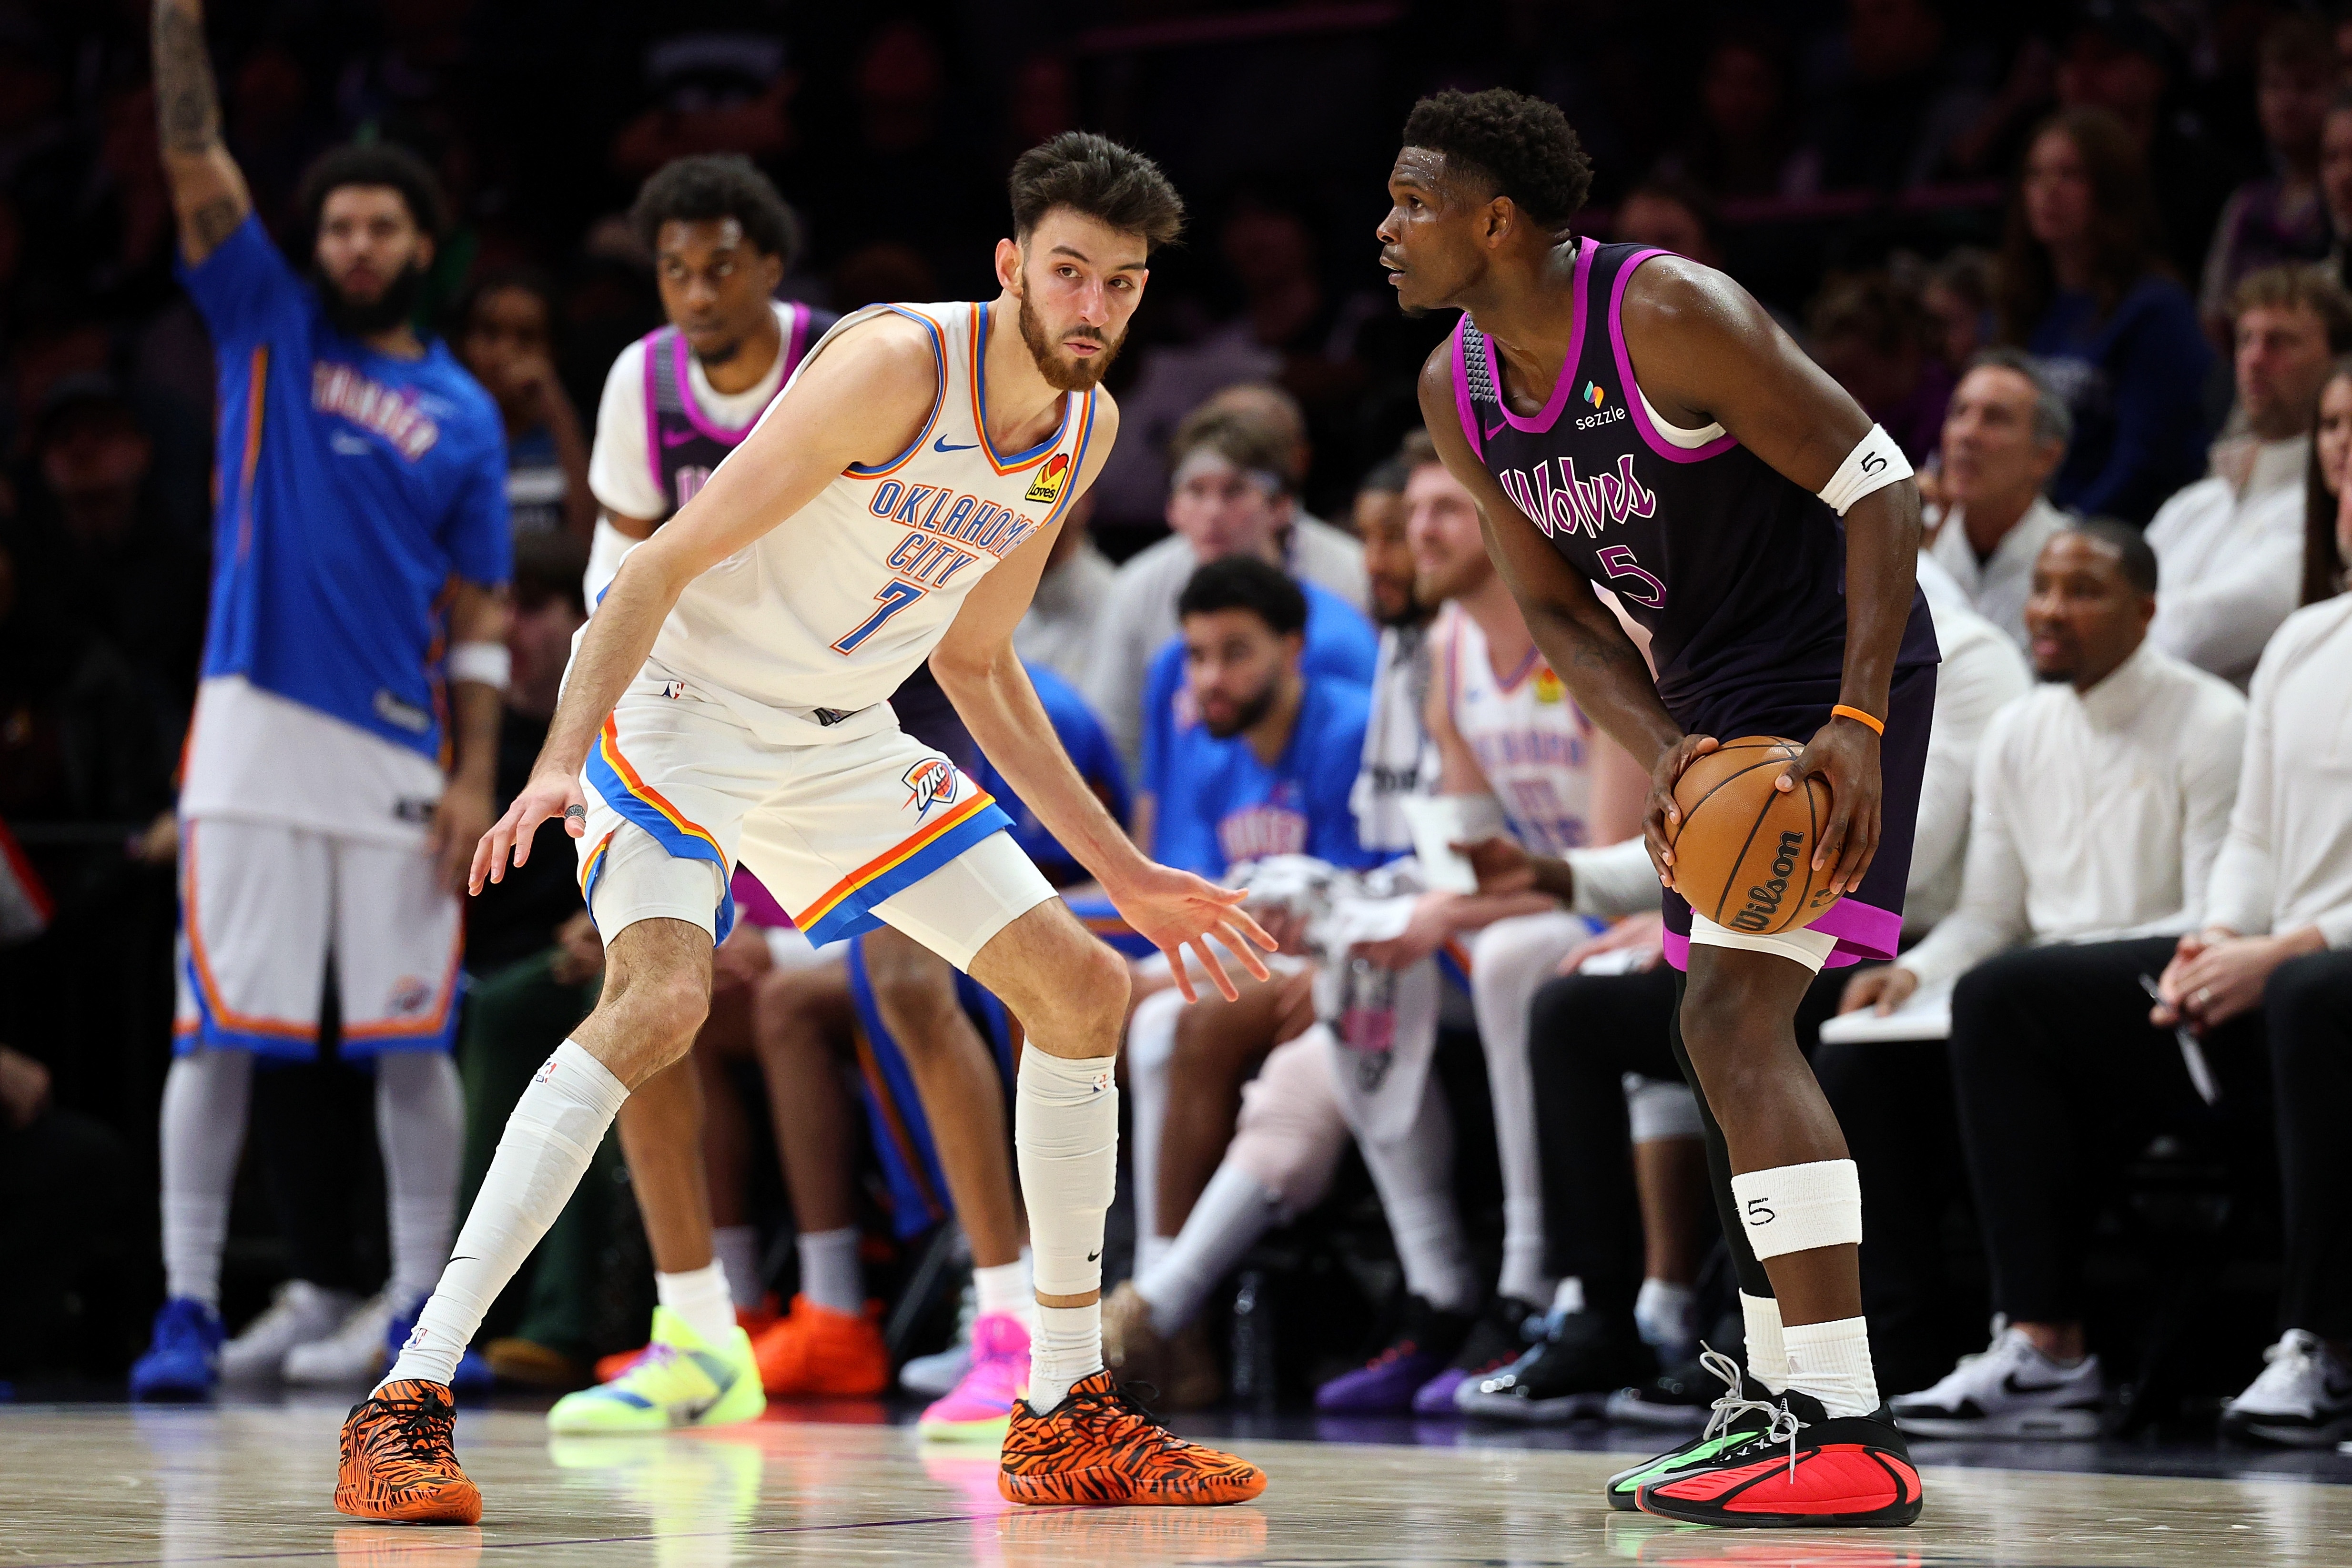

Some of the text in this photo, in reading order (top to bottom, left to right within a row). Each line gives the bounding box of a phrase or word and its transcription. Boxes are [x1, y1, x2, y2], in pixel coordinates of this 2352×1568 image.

[1575, 405, 1626, 430] sezzle
[1861, 451, 1887, 477] 5
[1499, 454, 1656, 539] Wolves
[886, 531, 979, 589] CITY
[1595, 545, 1667, 609] 5
[830, 577, 930, 656] 7
[916, 762, 947, 811] OKC
[1728, 830, 1805, 931] Wilson
[1747, 1197, 1775, 1226] 5
